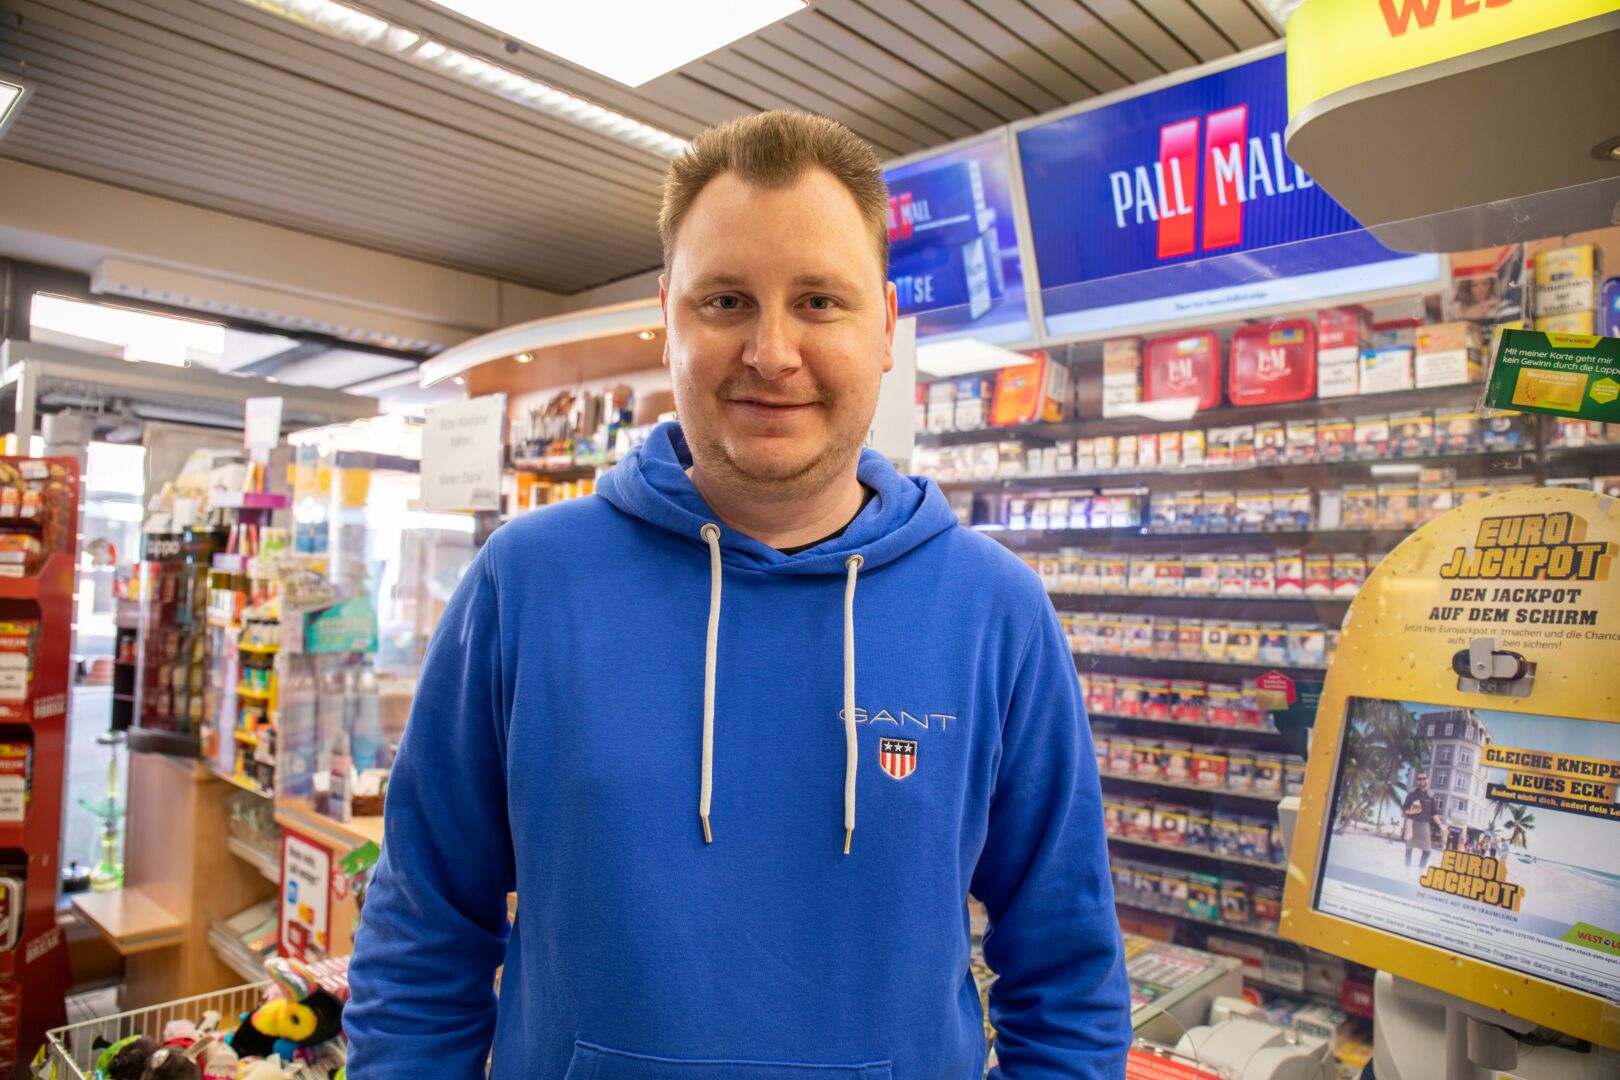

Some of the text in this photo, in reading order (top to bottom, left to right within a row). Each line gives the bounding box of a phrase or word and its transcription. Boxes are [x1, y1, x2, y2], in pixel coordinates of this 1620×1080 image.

[1110, 157, 1193, 228] PALL
[1502, 355, 1520, 364] kein
[1520, 357, 1552, 367] Gewinn
[1553, 361, 1579, 371] durch
[1579, 364, 1594, 372] die
[1504, 347, 1614, 364] Mit meiner Karte geht mir
[1475, 512, 1574, 548] EURO
[1440, 542, 1607, 580] JACKPOT
[1450, 588, 1581, 604] DEN JACKPOT
[1429, 607, 1598, 626] AUF DEM SCHIRM
[1404, 623, 1423, 632] Jetzt
[1423, 624, 1437, 633] bei
[1439, 625, 1488, 637] Eurojackpot
[1544, 629, 1564, 639] und
[1566, 630, 1581, 640] die
[1447, 637, 1465, 645] aufs
[1522, 640, 1563, 650] sichern!
[838, 707, 957, 731] GANT
[1486, 749, 1620, 780] GLEICHE KNEIPE
[1511, 773, 1610, 800] NEUES ECK.
[1588, 804, 1608, 815] dein
[1442, 850, 1498, 881] EURO
[1420, 866, 1519, 910] JACKPOT
[1577, 931, 1603, 945] WEST
